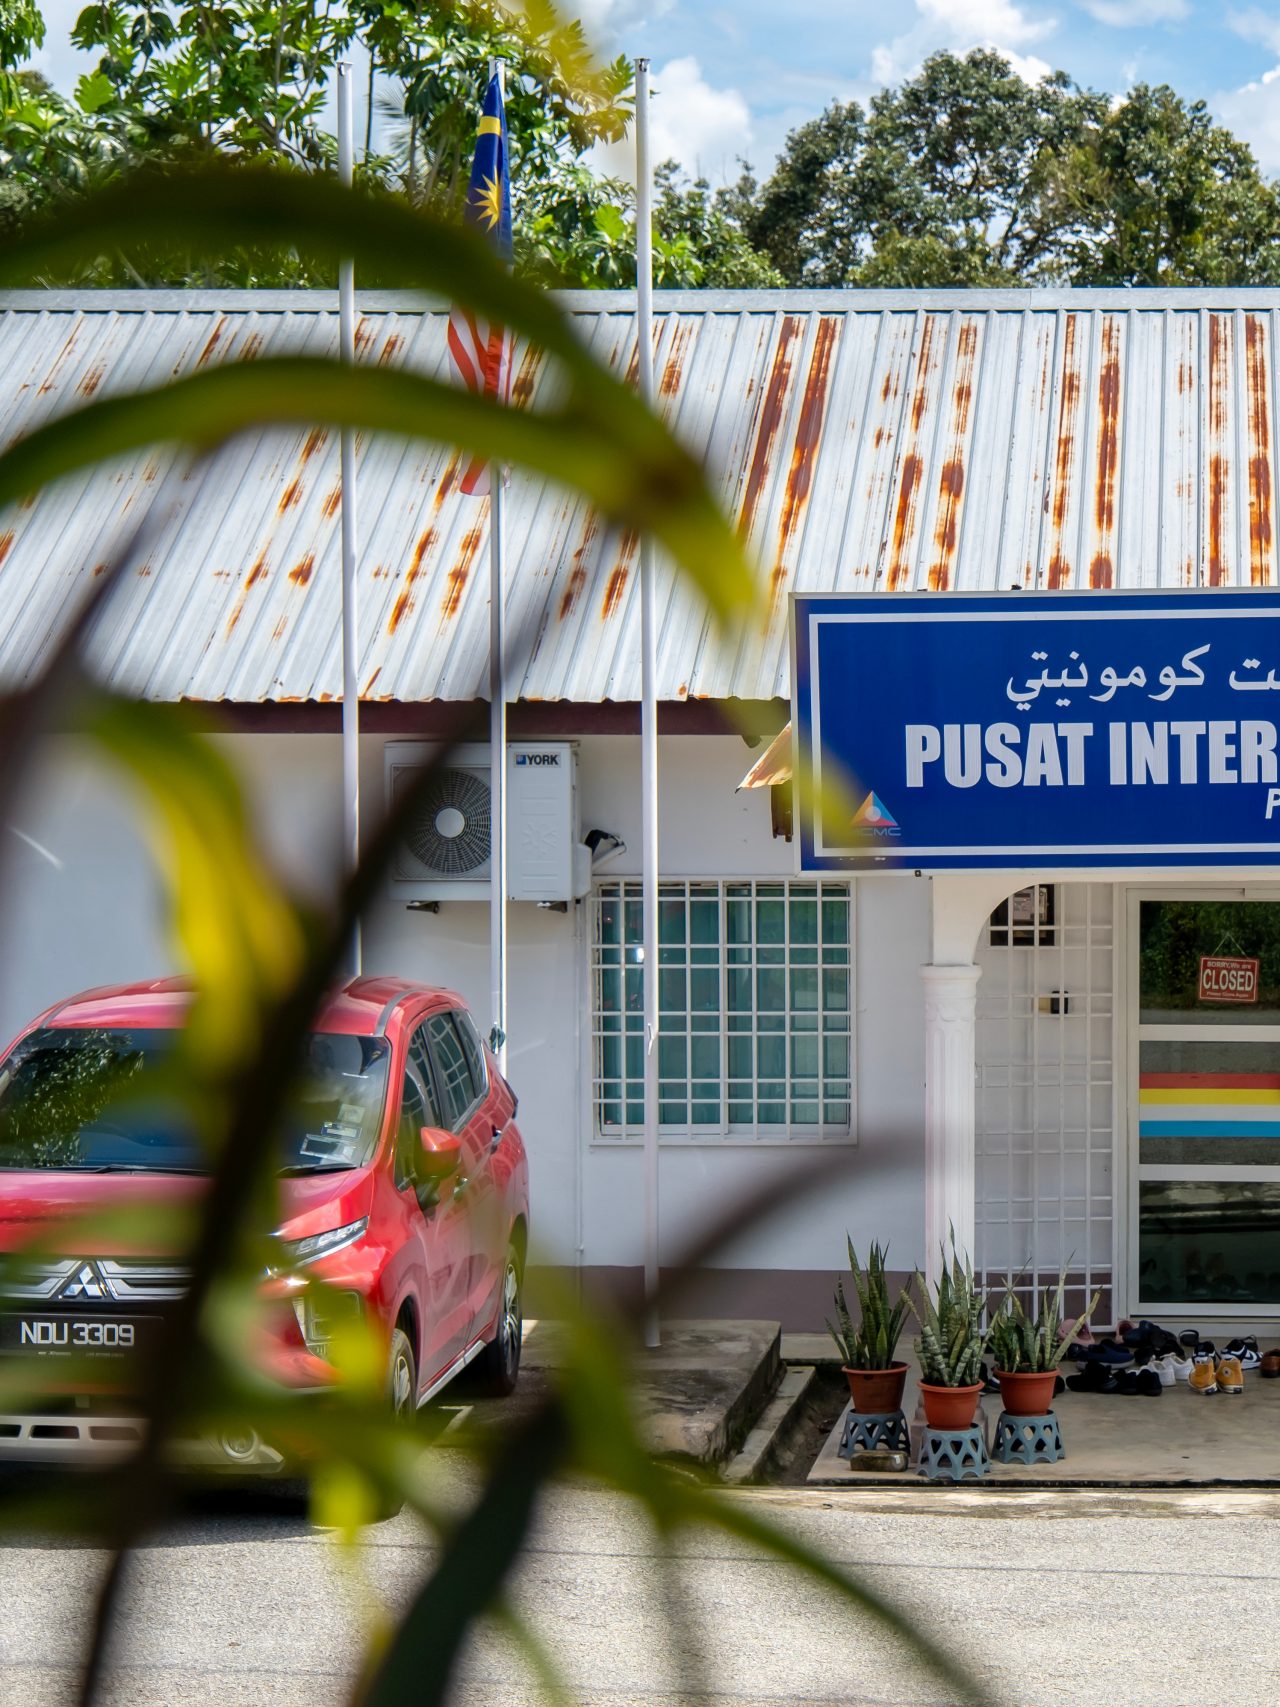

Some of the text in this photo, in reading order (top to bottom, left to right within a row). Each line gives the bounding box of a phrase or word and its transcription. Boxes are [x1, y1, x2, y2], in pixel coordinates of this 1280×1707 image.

[527, 754, 559, 765] YORK
[905, 722, 1094, 788] PUSAT
[848, 827, 901, 836] CMC
[1203, 968, 1254, 991] CLOSED
[20, 1321, 135, 1346] NDU 3309
